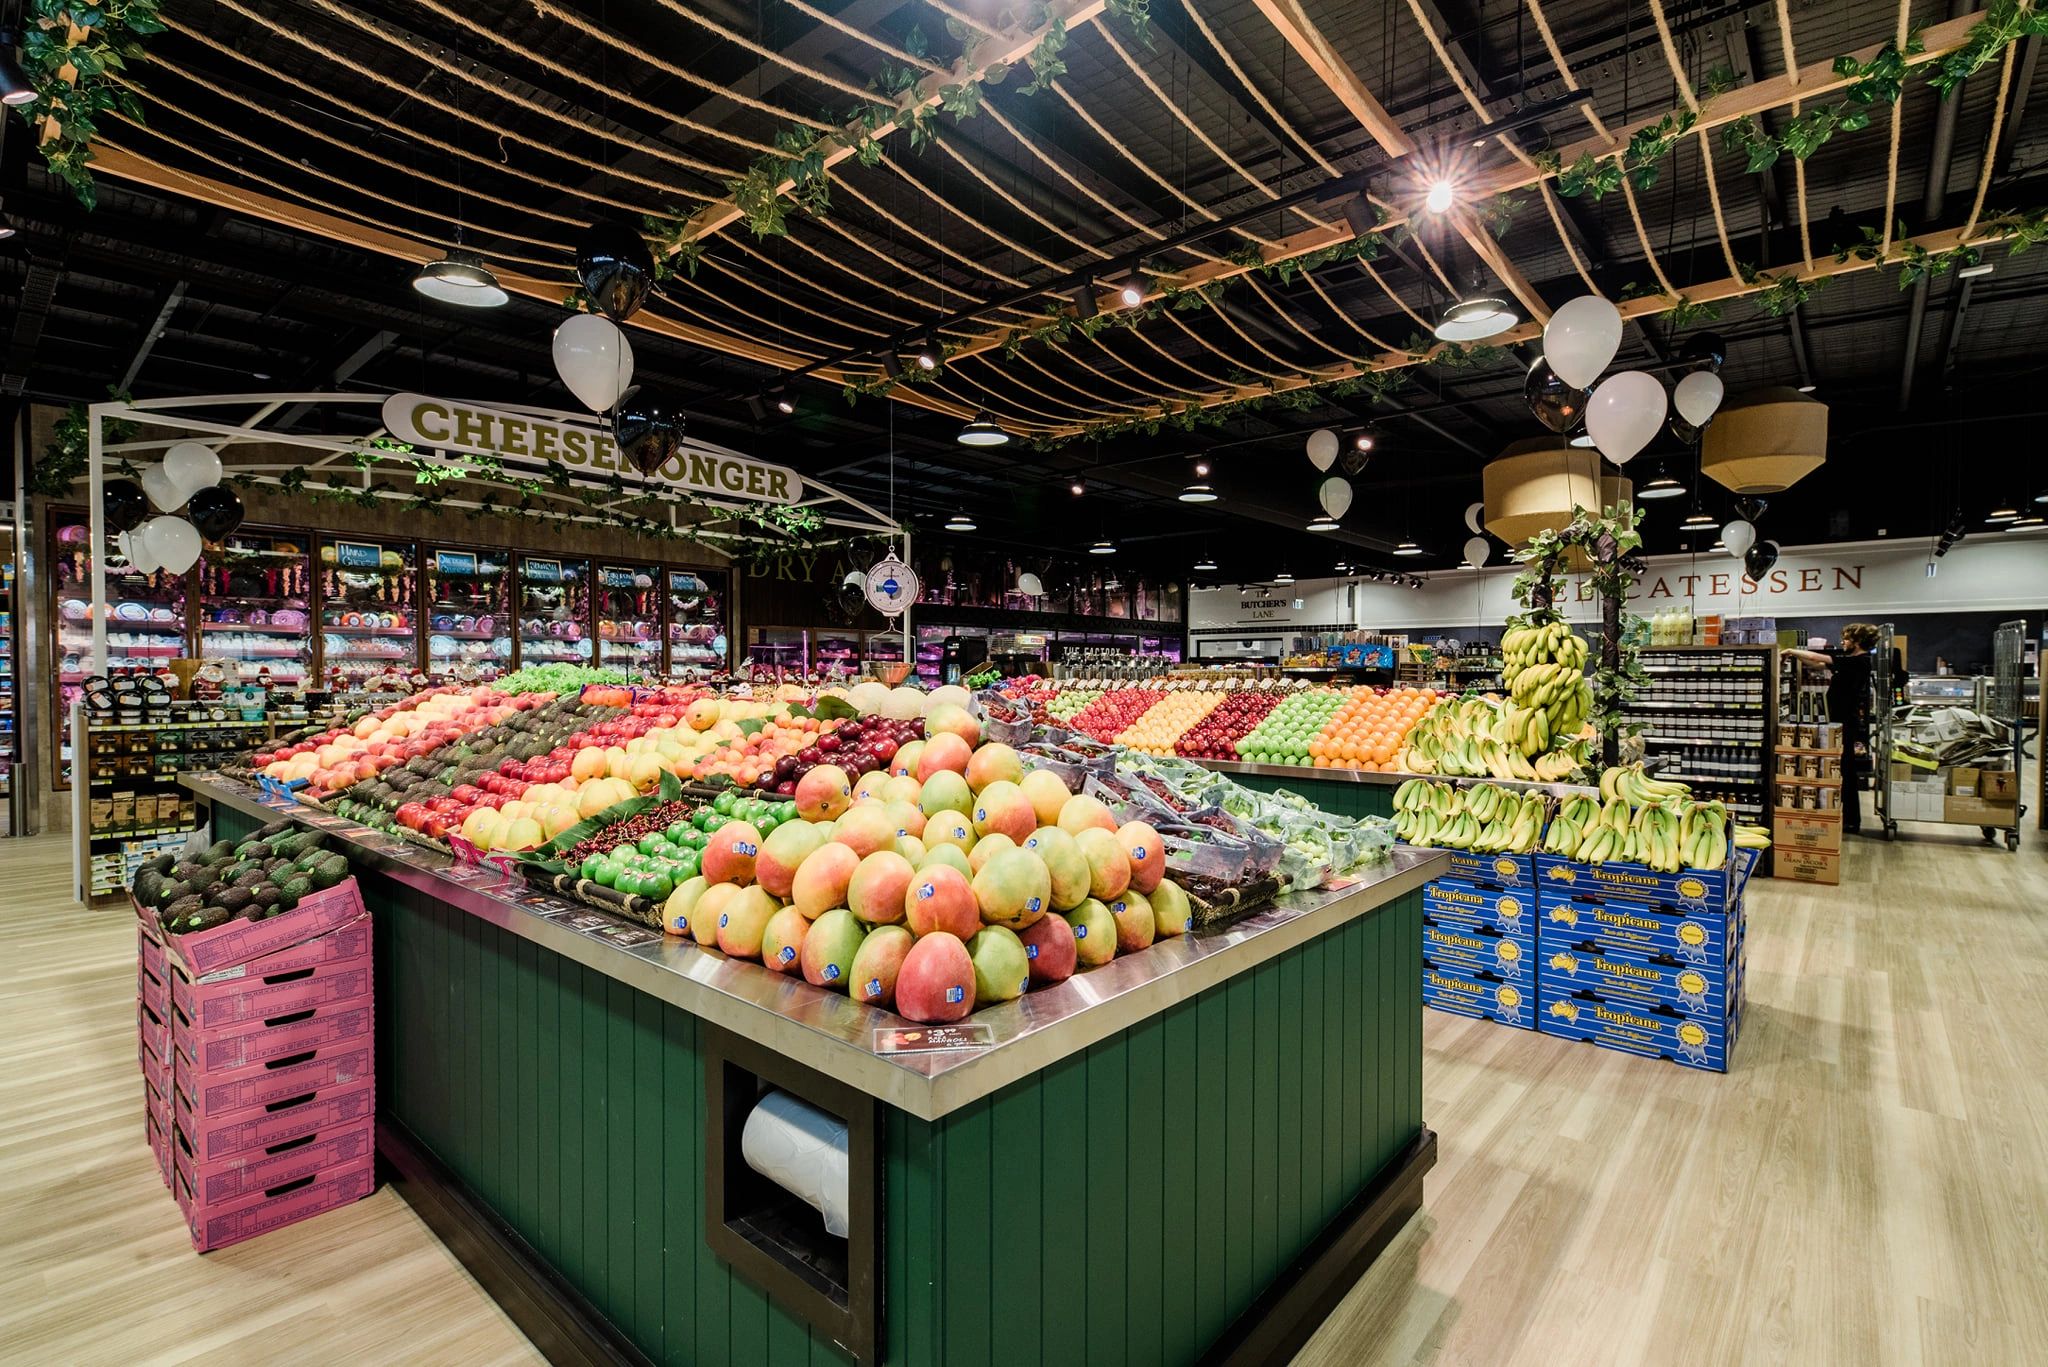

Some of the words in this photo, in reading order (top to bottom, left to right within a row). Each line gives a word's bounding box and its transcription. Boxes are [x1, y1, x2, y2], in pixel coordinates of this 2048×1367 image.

[411, 403, 790, 500] CHEESEONGER
[748, 553, 818, 582] DRY
[1252, 610, 1274, 619] LANE
[1592, 869, 1660, 886] Tropicana
[1430, 886, 1484, 905] Tropicana
[1594, 909, 1661, 930] Tropicana
[1430, 930, 1483, 950] Tropicana
[1594, 958, 1661, 981] Tropicana
[1430, 973, 1483, 994] Tropicana
[1595, 1006, 1661, 1031] Tropicana
